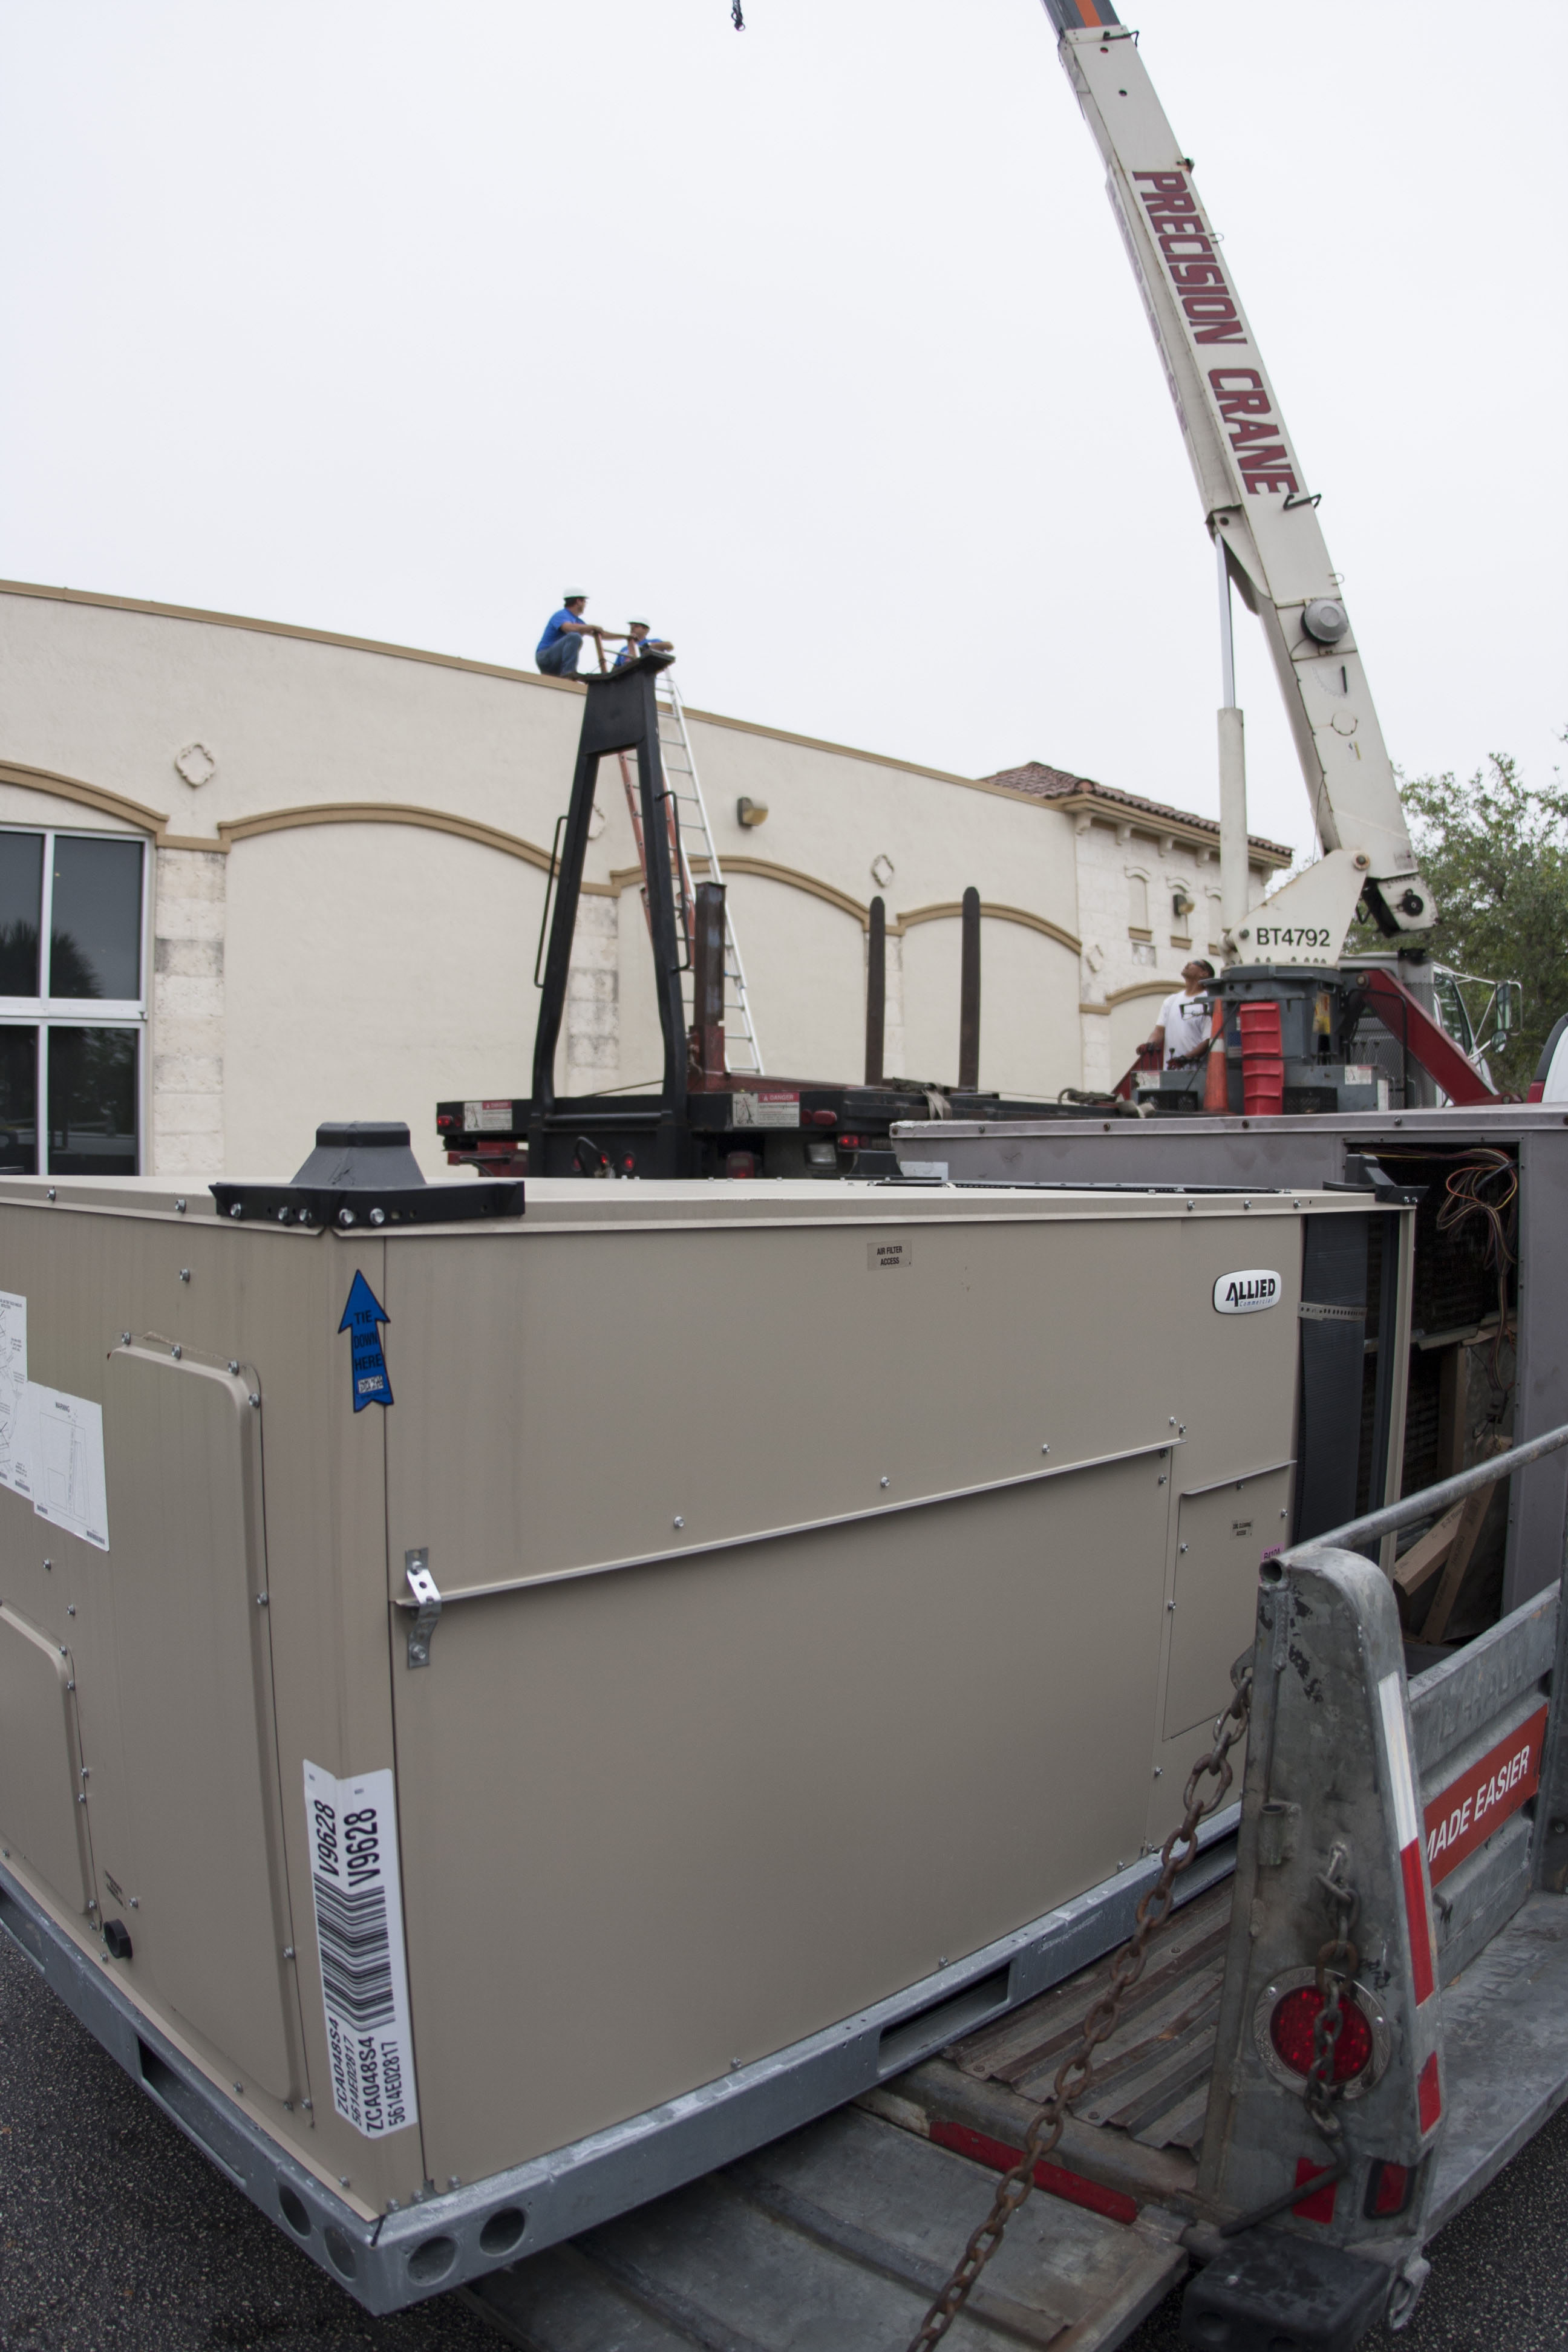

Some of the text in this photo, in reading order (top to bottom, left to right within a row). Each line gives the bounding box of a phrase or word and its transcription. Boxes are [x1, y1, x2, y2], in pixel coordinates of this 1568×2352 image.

[1132, 171, 1248, 345] PRECISION
[1207, 368, 1300, 495] CRANE
[1256, 927, 1331, 947] BT4792
[877, 1246, 903, 1255] AIR FILTER
[880, 1257, 900, 1266] ACCESS
[354, 1310, 373, 1325] TIE
[1225, 1278, 1275, 1307] ALLIED
[1240, 1298, 1273, 1307] Commercial
[353, 1332, 378, 1349] DOWN
[353, 1354, 383, 1371] HERE
[1474, 1745, 1530, 1823] EASIER
[314, 1799, 339, 1877] V9628
[344, 1808, 381, 1887] V9628
[328, 2016, 349, 2115] ZCA048S4
[343, 2034, 362, 2127] 5614E02817
[358, 2036, 384, 2132] ZCA048S4
[381, 2041, 405, 2127] 5614E02817
